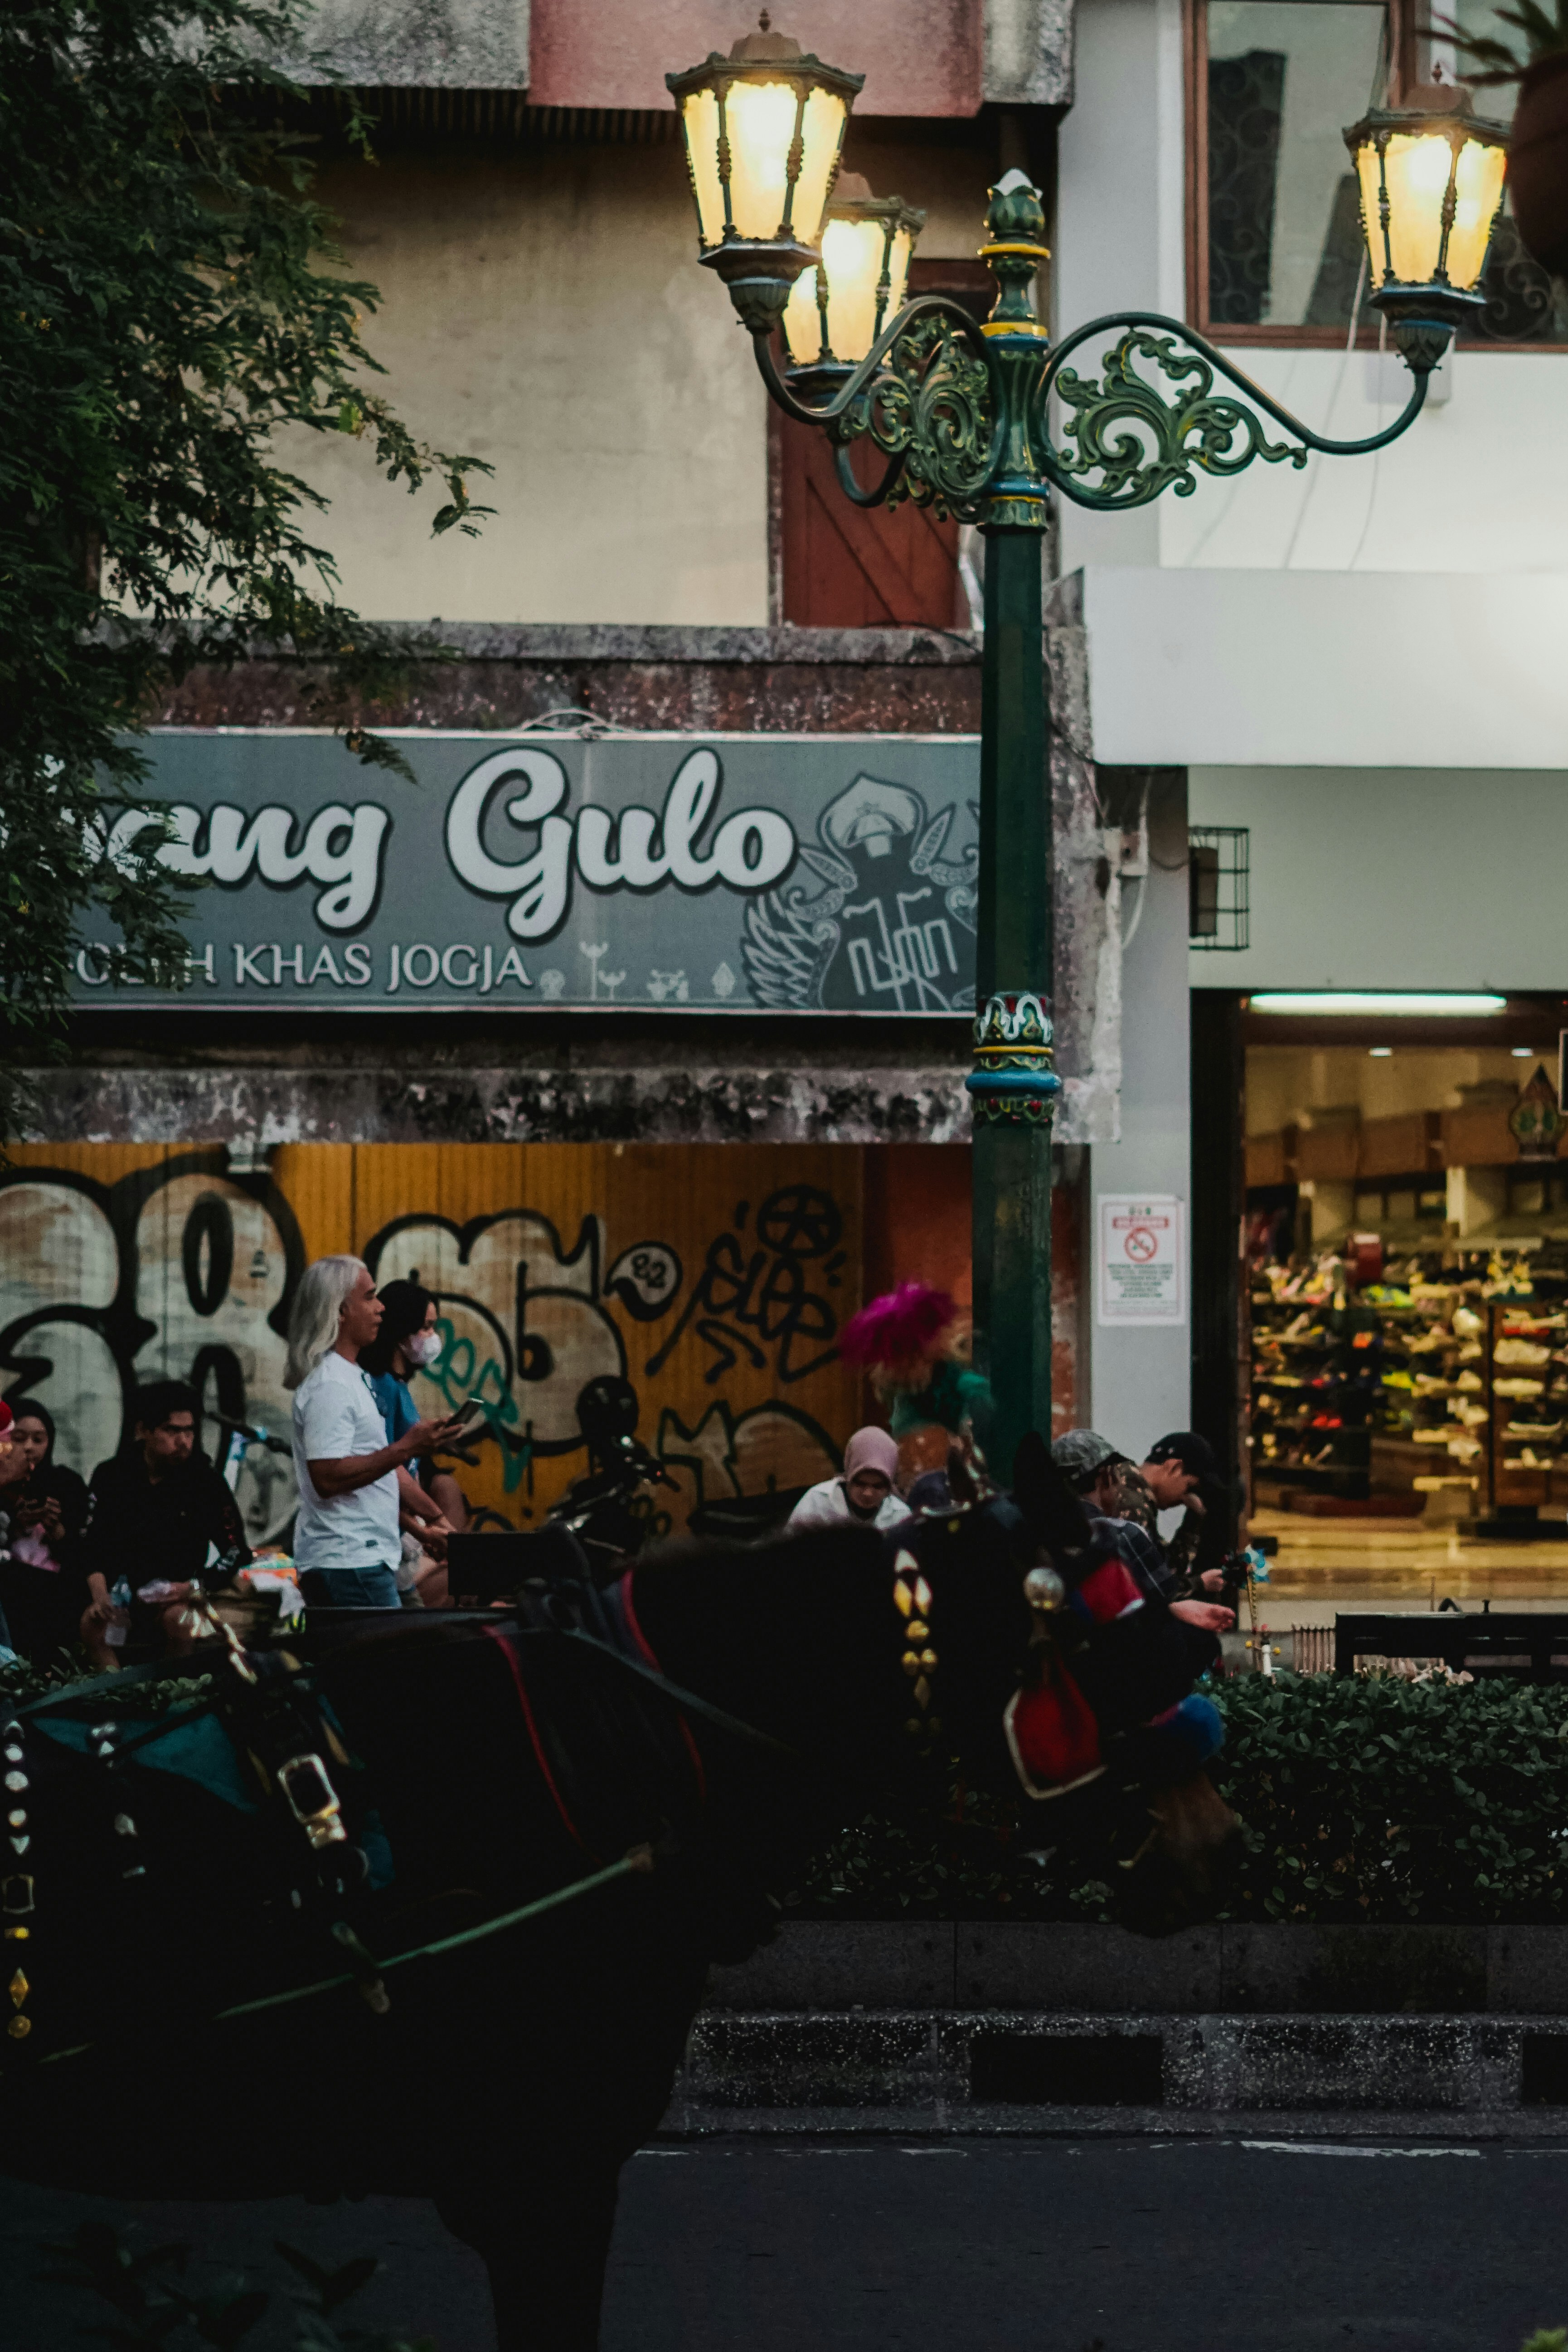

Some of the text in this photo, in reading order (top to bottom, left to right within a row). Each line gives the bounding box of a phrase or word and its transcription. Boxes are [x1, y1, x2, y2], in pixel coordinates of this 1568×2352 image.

[447, 746, 796, 938] Gulo
[233, 943, 372, 986] KHAS
[386, 943, 533, 994] JOGJA
[633, 1254, 666, 1288] 82
